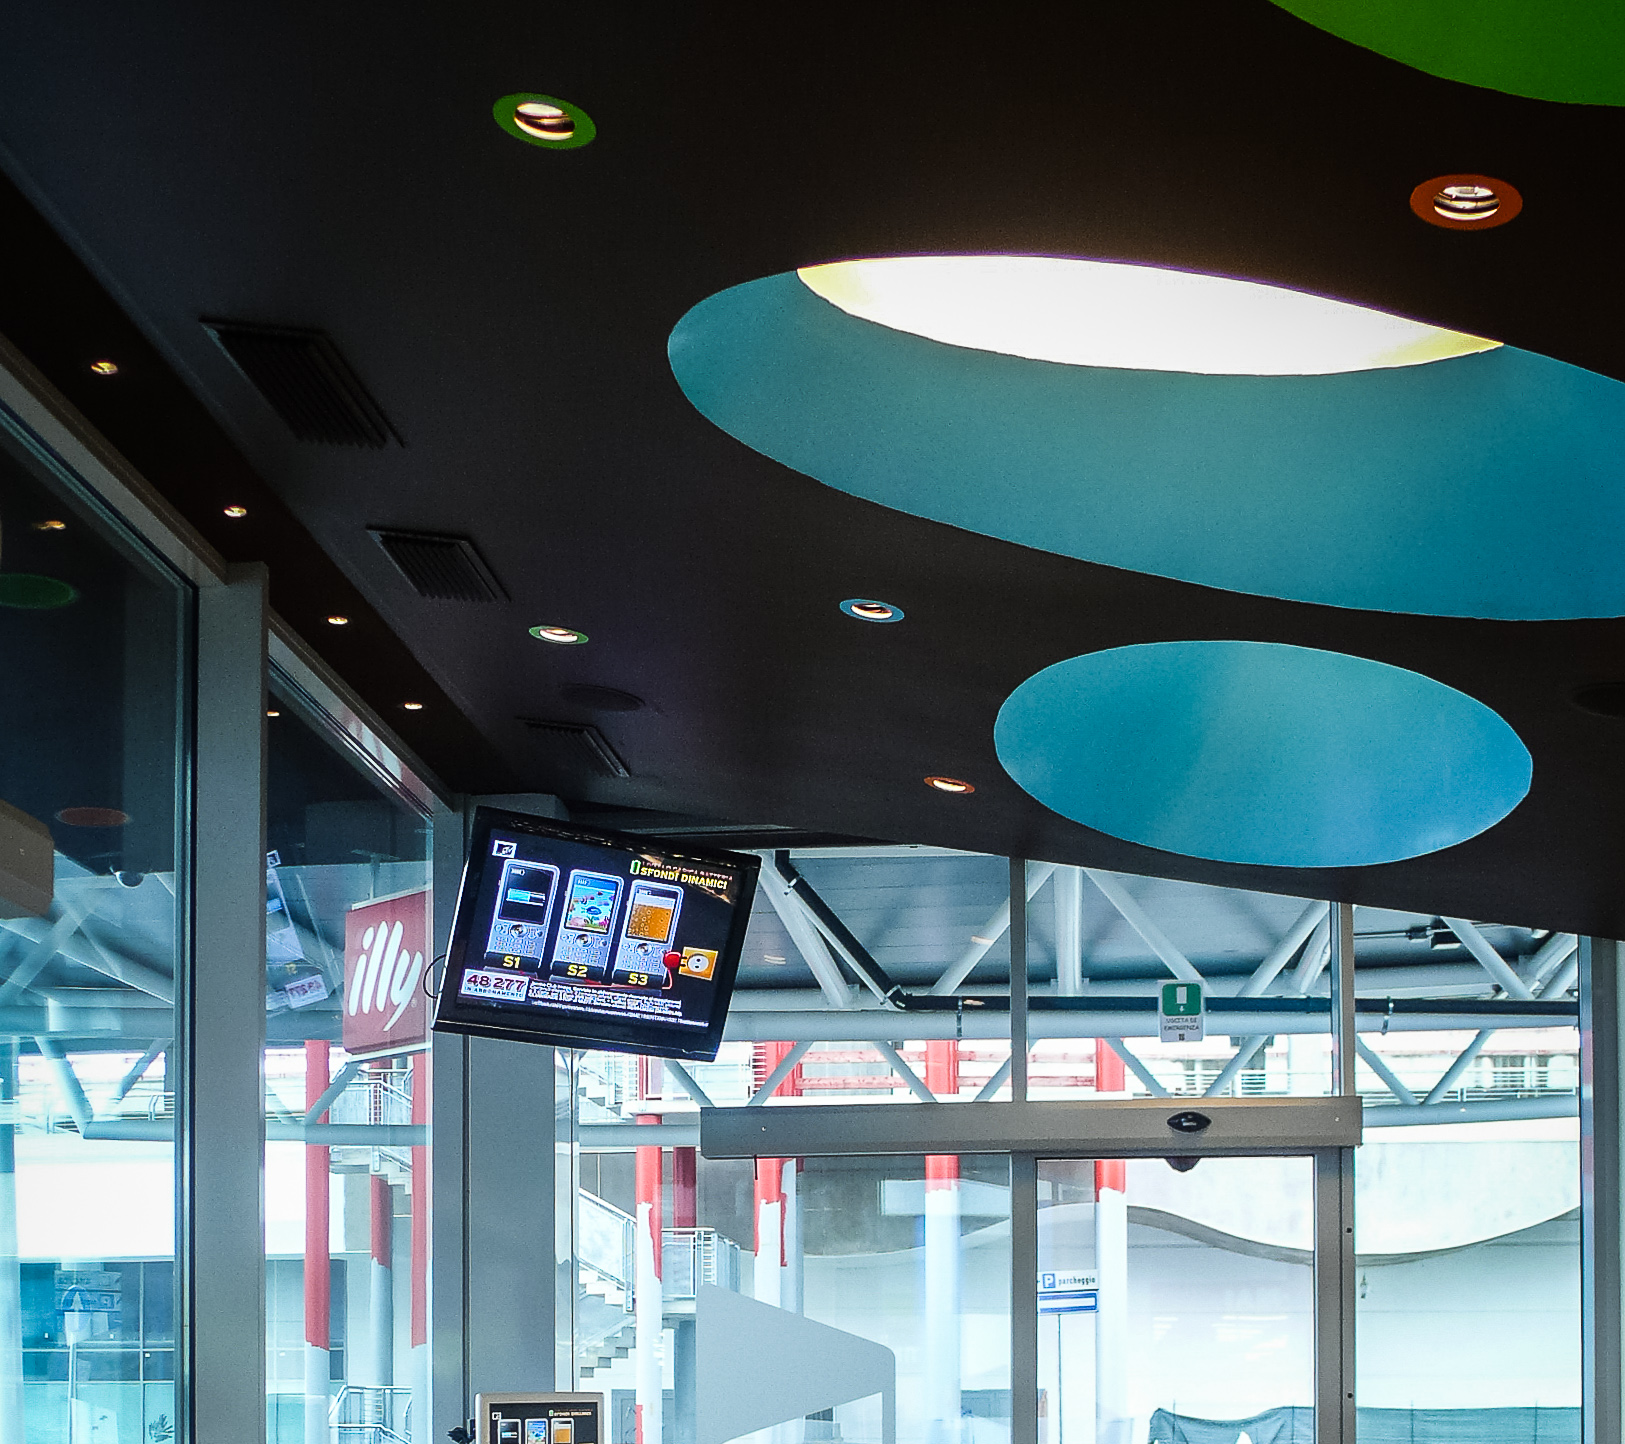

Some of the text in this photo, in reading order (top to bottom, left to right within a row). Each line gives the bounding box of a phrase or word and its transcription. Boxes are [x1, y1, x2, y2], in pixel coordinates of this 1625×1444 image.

[640, 867, 680, 882] SFONDI
[681, 873, 728, 890] DINAMICI
[503, 955, 521, 968] S1
[348, 920, 424, 1032] illy
[567, 964, 588, 977] S2
[467, 974, 526, 993] 48 277
[628, 972, 649, 986] S3
[1058, 1276, 1096, 1286] parcheggio
